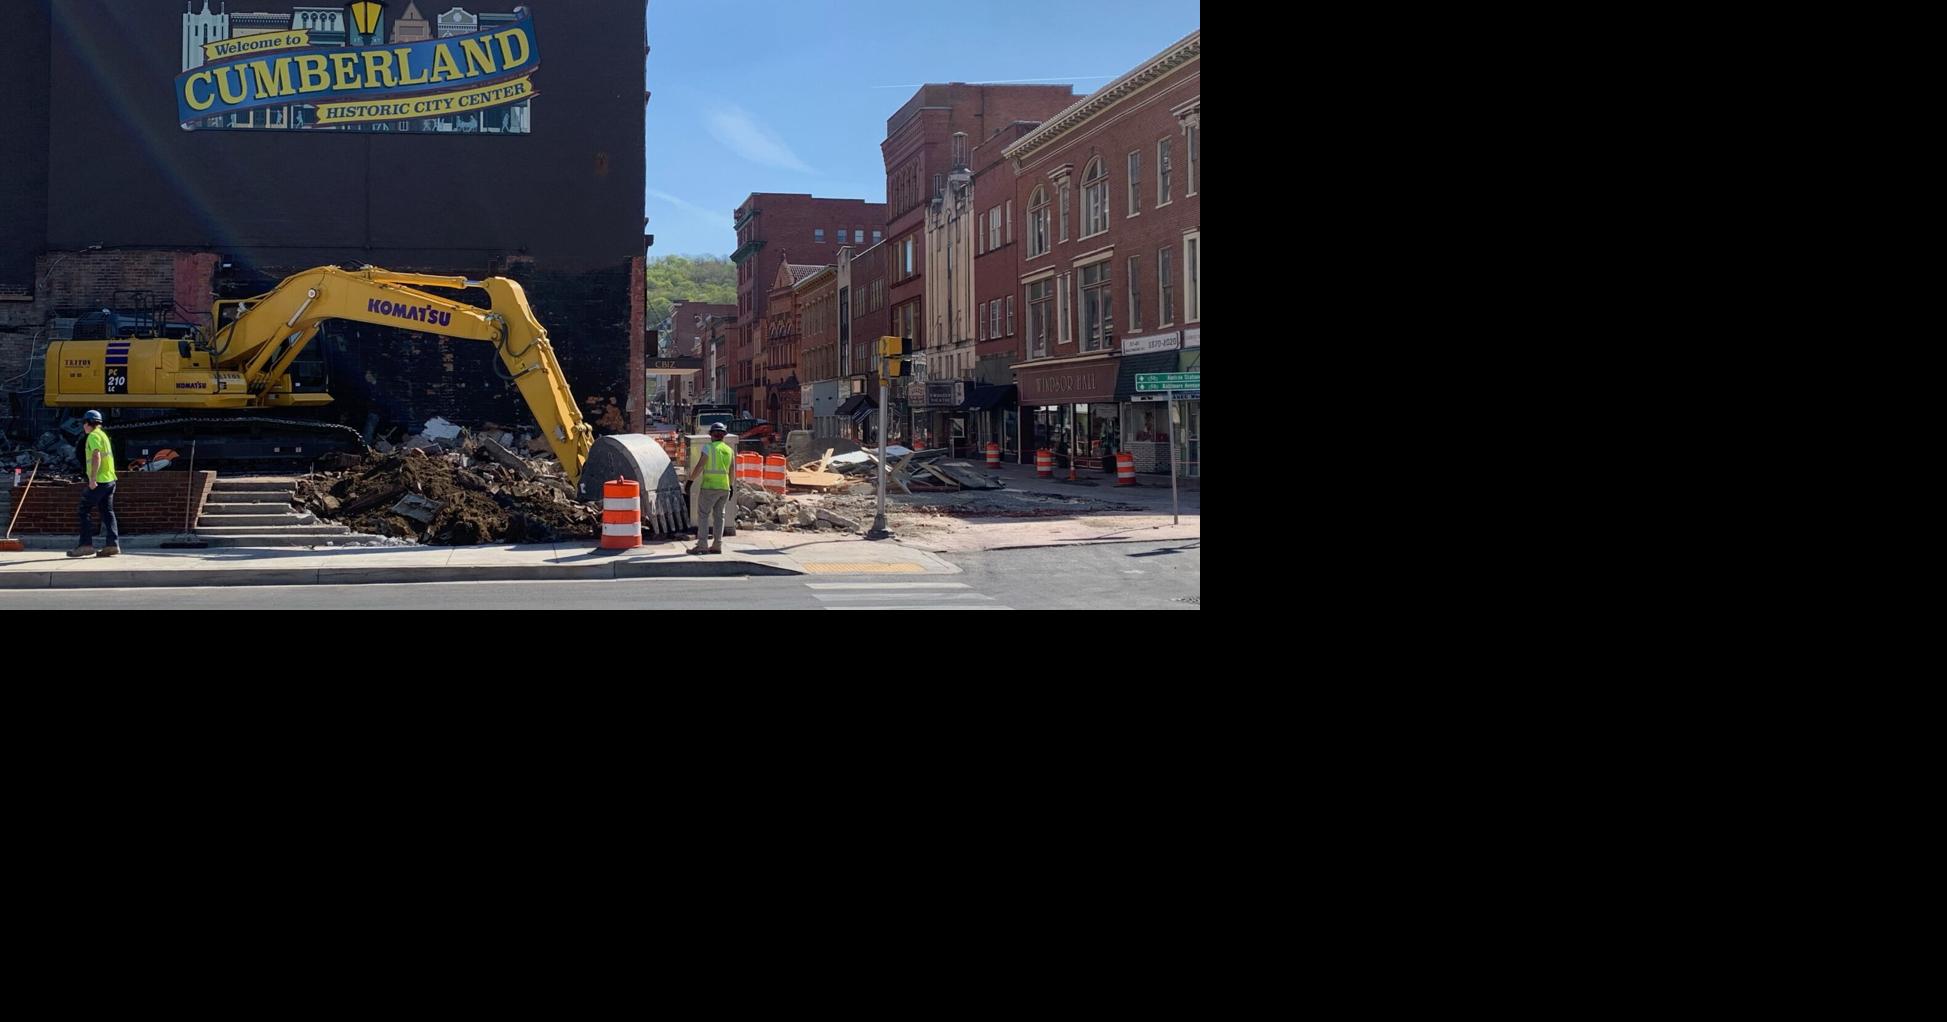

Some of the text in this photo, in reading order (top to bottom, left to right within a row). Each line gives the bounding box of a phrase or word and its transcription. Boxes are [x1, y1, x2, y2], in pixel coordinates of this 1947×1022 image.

[215, 34, 301, 56] Welcome to
[184, 27, 531, 111] CUMBERLAND
[326, 82, 526, 119] HISTORIC CITY CENTER
[367, 298, 451, 327] KOMATSU
[107, 368, 118, 377] PC
[655, 361, 676, 369] CBIZ
[107, 376, 126, 387] 210
[176, 381, 207, 389] KOMATSU
[1035, 375, 1073, 393] WINDSOR
